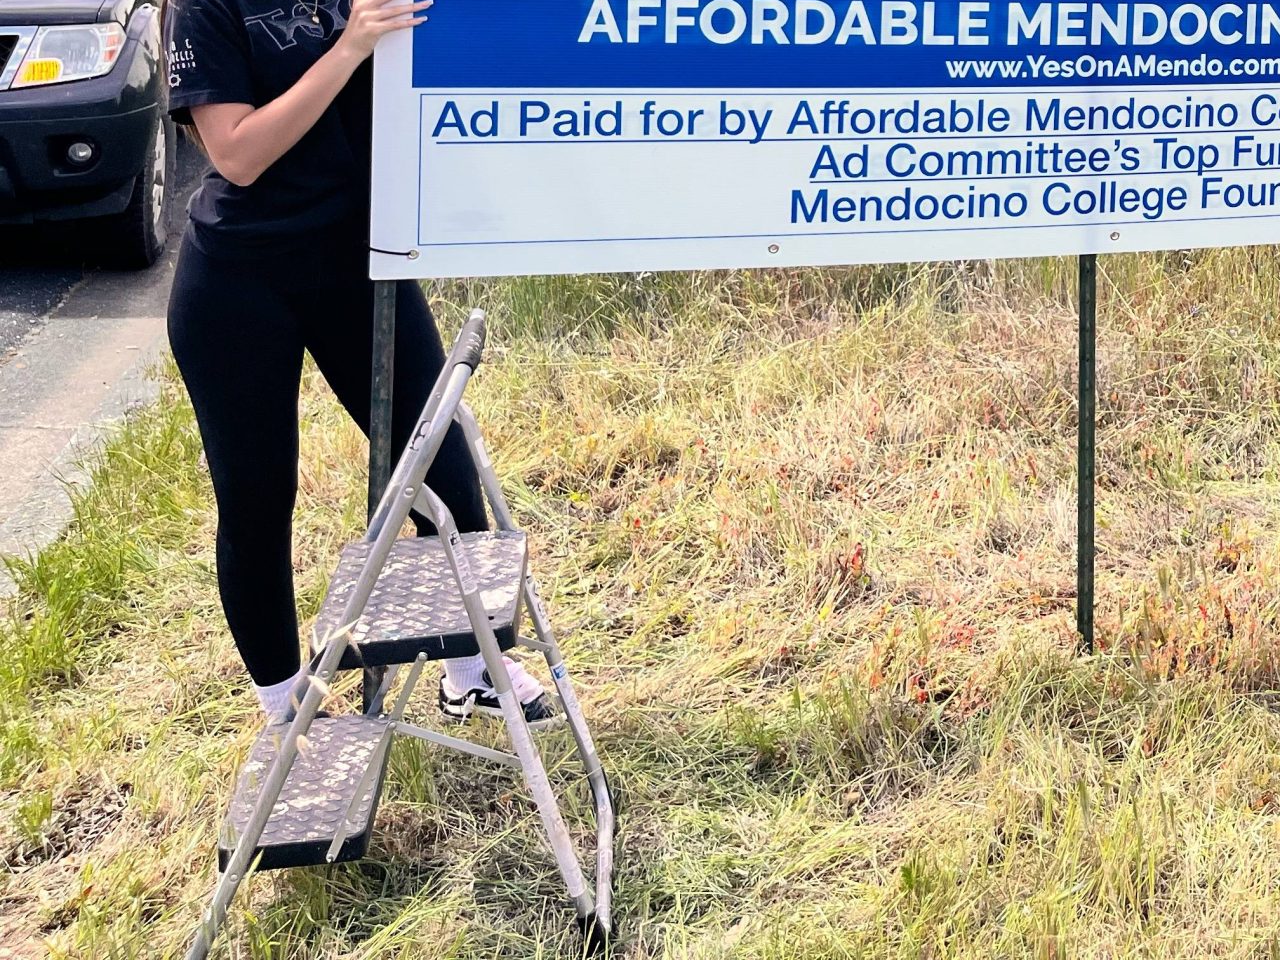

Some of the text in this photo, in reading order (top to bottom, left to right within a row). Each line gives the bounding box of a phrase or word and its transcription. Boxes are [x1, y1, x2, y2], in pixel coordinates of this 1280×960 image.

[432, 101, 498, 137] Ad
[520, 101, 621, 136] Paid
[640, 101, 703, 135] for
[719, 100, 772, 144] by
[787, 100, 1009, 134] Affordable
[1026, 97, 1238, 130] Mendocino
[810, 145, 868, 178] Ad
[886, 140, 1139, 177] Committee’s
[1154, 137, 1219, 176] Top
[791, 186, 1027, 223] Mendocino
[1043, 181, 1187, 220] College
